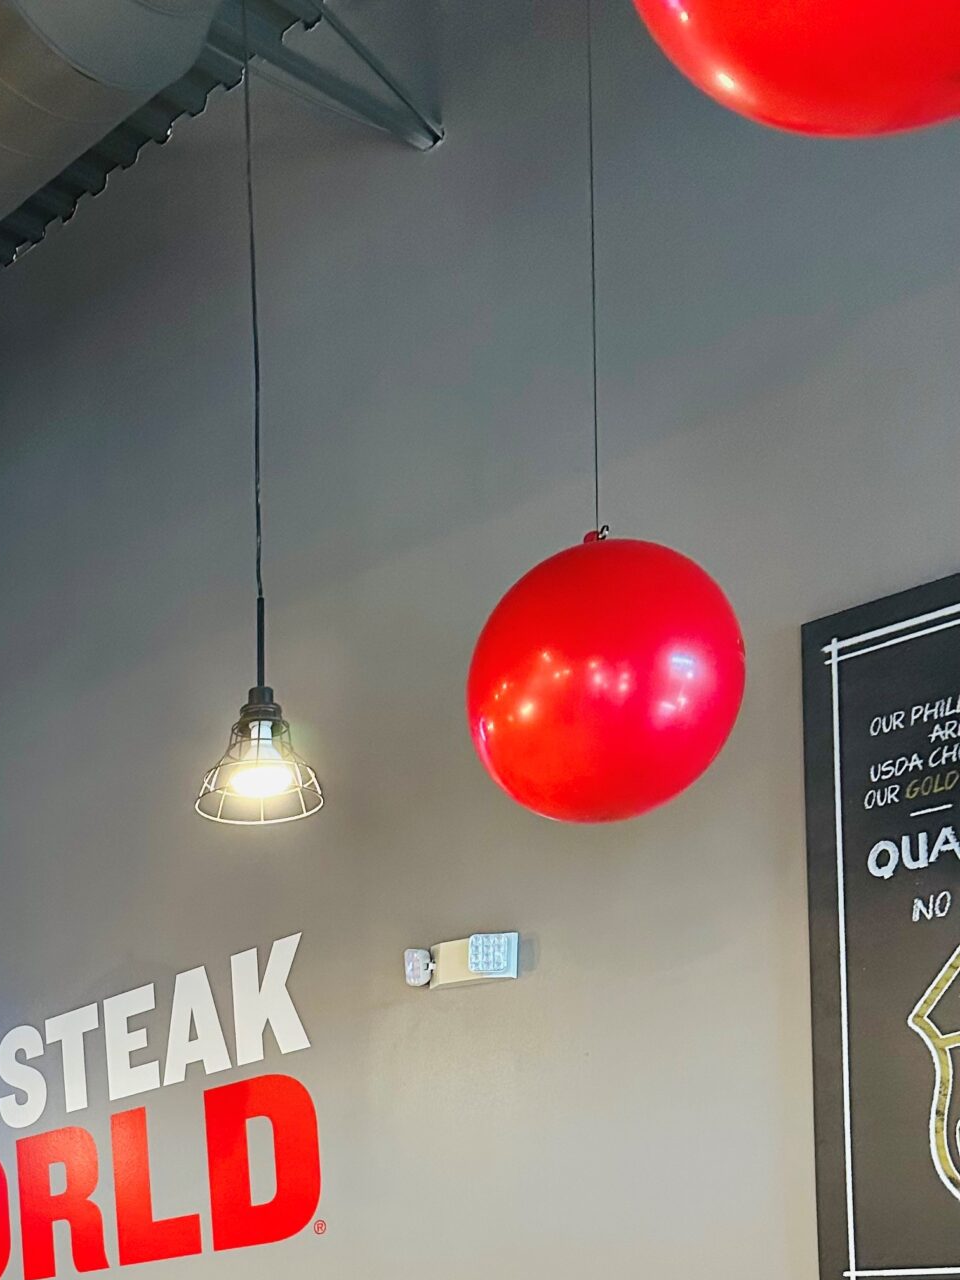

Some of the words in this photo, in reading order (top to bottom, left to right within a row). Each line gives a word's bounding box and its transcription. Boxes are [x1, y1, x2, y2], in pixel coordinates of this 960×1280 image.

[870, 711, 905, 737] OUR
[928, 720, 960, 743] AR
[870, 753, 924, 783] USDA
[928, 743, 960, 768] CH
[864, 785, 900, 810] OUR
[905, 770, 960, 799] GOLD
[912, 891, 952, 922] NO
